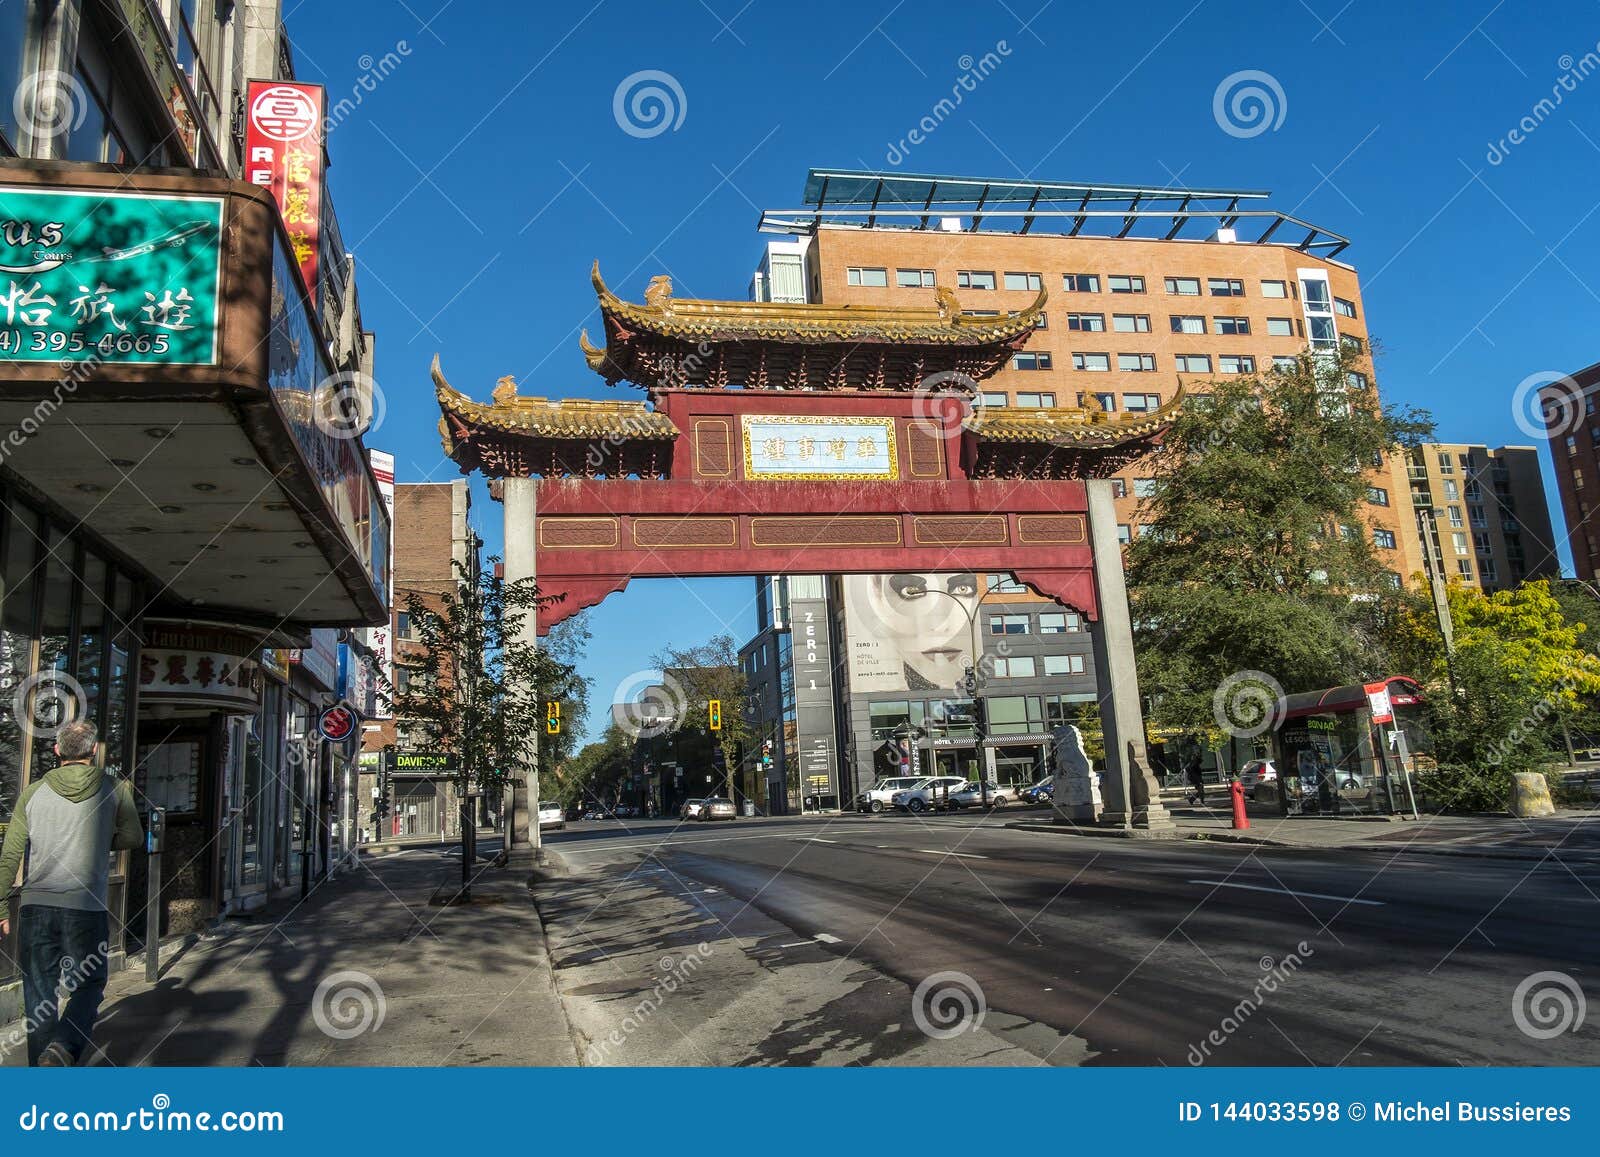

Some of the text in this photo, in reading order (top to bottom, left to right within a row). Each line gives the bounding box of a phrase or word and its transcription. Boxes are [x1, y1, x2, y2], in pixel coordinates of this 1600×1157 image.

[30, 331, 170, 354] 395-4665
[805, 612, 817, 690] ZERO 1
